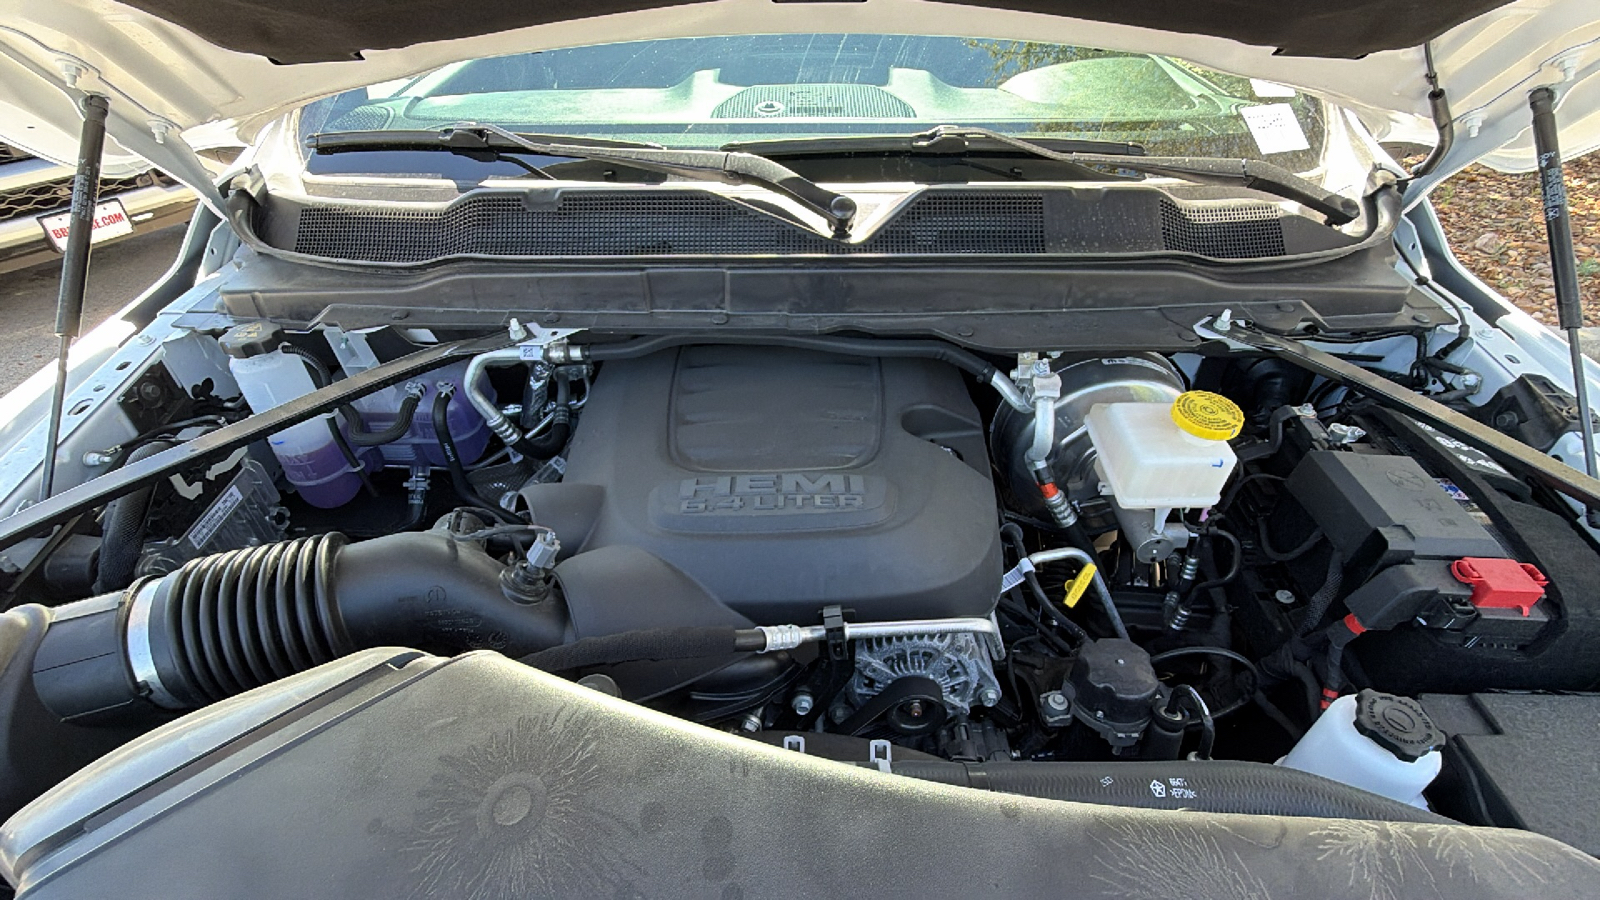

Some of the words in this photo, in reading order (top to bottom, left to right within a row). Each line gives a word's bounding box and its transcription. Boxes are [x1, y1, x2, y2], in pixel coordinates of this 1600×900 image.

[679, 473, 866, 499] HEMI
[679, 496, 746, 514] 6.4
[753, 493, 865, 511] LITER
